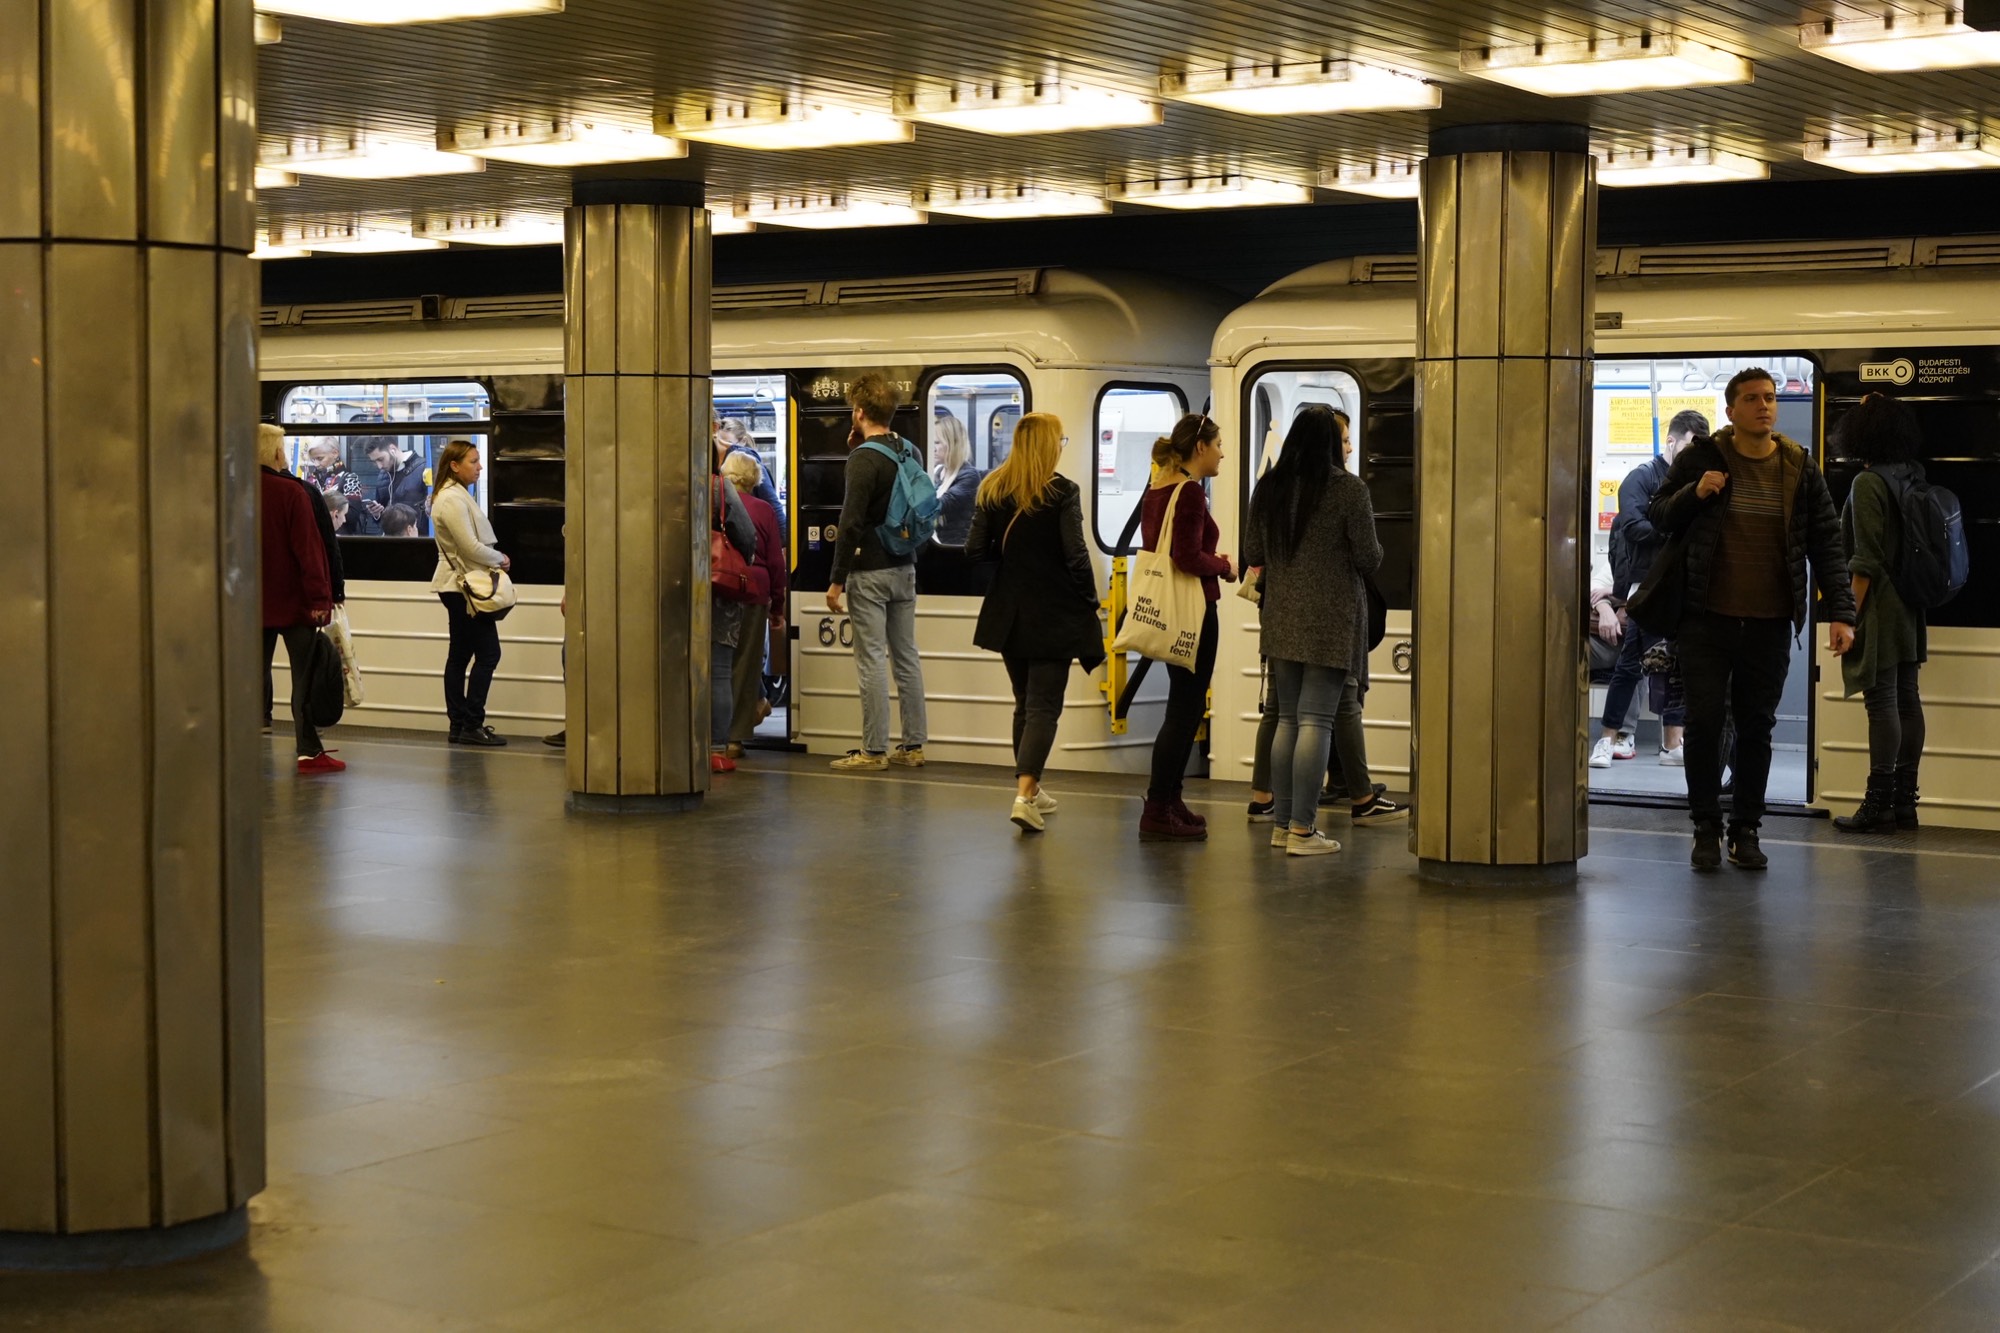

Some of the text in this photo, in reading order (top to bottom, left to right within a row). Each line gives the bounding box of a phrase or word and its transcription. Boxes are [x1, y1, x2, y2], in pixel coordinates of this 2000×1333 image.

[1919, 359, 1961, 367] BUDAPESTI
[1866, 368, 1890, 377] BKK
[1919, 366, 1970, 375] KÖZLEKEDÉSI
[1918, 375, 1955, 384] KÖZPONT
[1600, 481, 1615, 489] SOS
[1137, 595, 1152, 605] we
[1134, 602, 1161, 618] build
[1132, 611, 1167, 631] futures
[1180, 630, 1196, 641] not
[1175, 637, 1195, 650] just
[1169, 645, 1191, 658] tech
